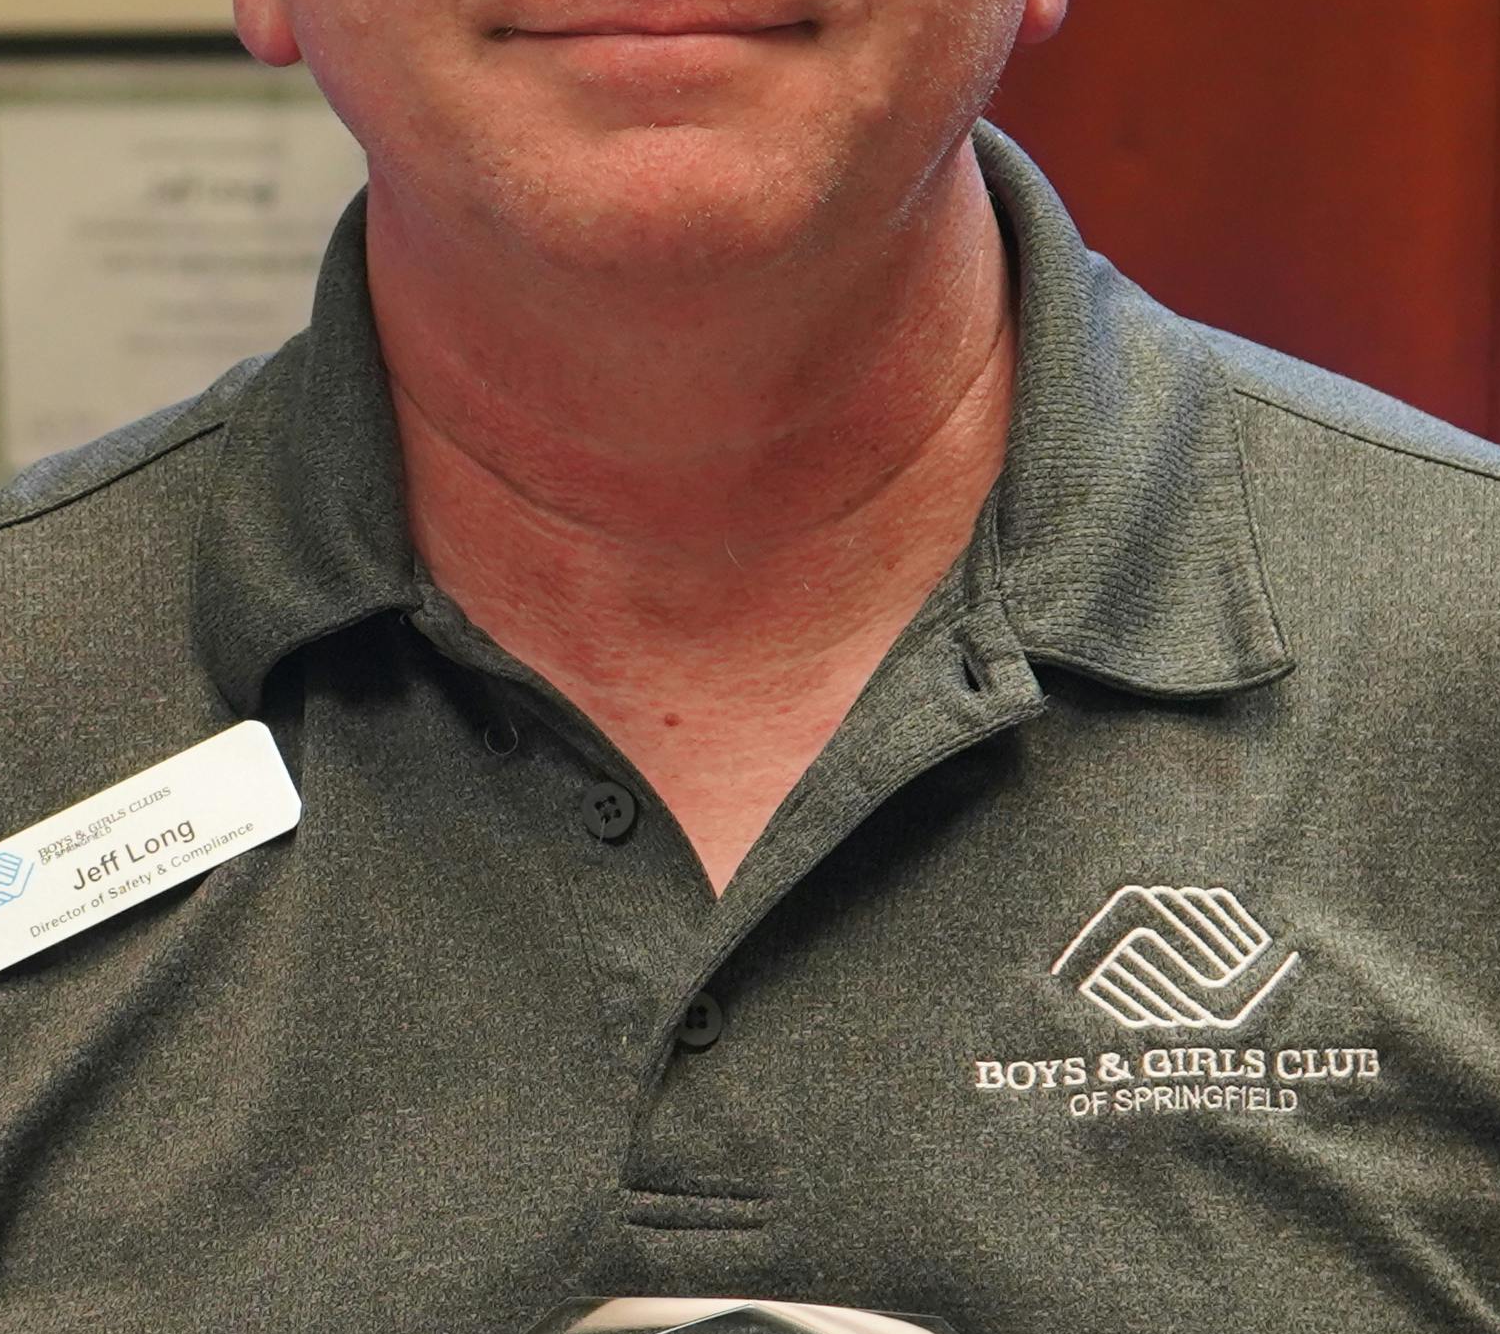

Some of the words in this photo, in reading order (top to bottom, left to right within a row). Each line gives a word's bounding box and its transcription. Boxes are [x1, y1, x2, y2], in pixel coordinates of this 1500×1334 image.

[38, 835, 73, 860] BOYS
[75, 829, 87, 840] &
[88, 808, 127, 833] GIRLS
[129, 786, 171, 813] CLUBS
[41, 854, 52, 866] OF
[55, 826, 112, 859] SPRINGFIELD
[29, 903, 87, 938] Director
[91, 892, 106, 909] of
[108, 871, 153, 900] Safety
[157, 863, 168, 876] &
[171, 821, 255, 868] Compliance
[73, 849, 120, 891] Jeff
[125, 820, 196, 863] Long
[974, 1057, 1088, 1091] BOYS
[1098, 1052, 1134, 1083] &
[1142, 1048, 1267, 1079] GIRLS
[1275, 1048, 1382, 1081] CLUB
[1069, 1090, 1108, 1117] OF
[1113, 1085, 1298, 1113] SPRINGFIELD
